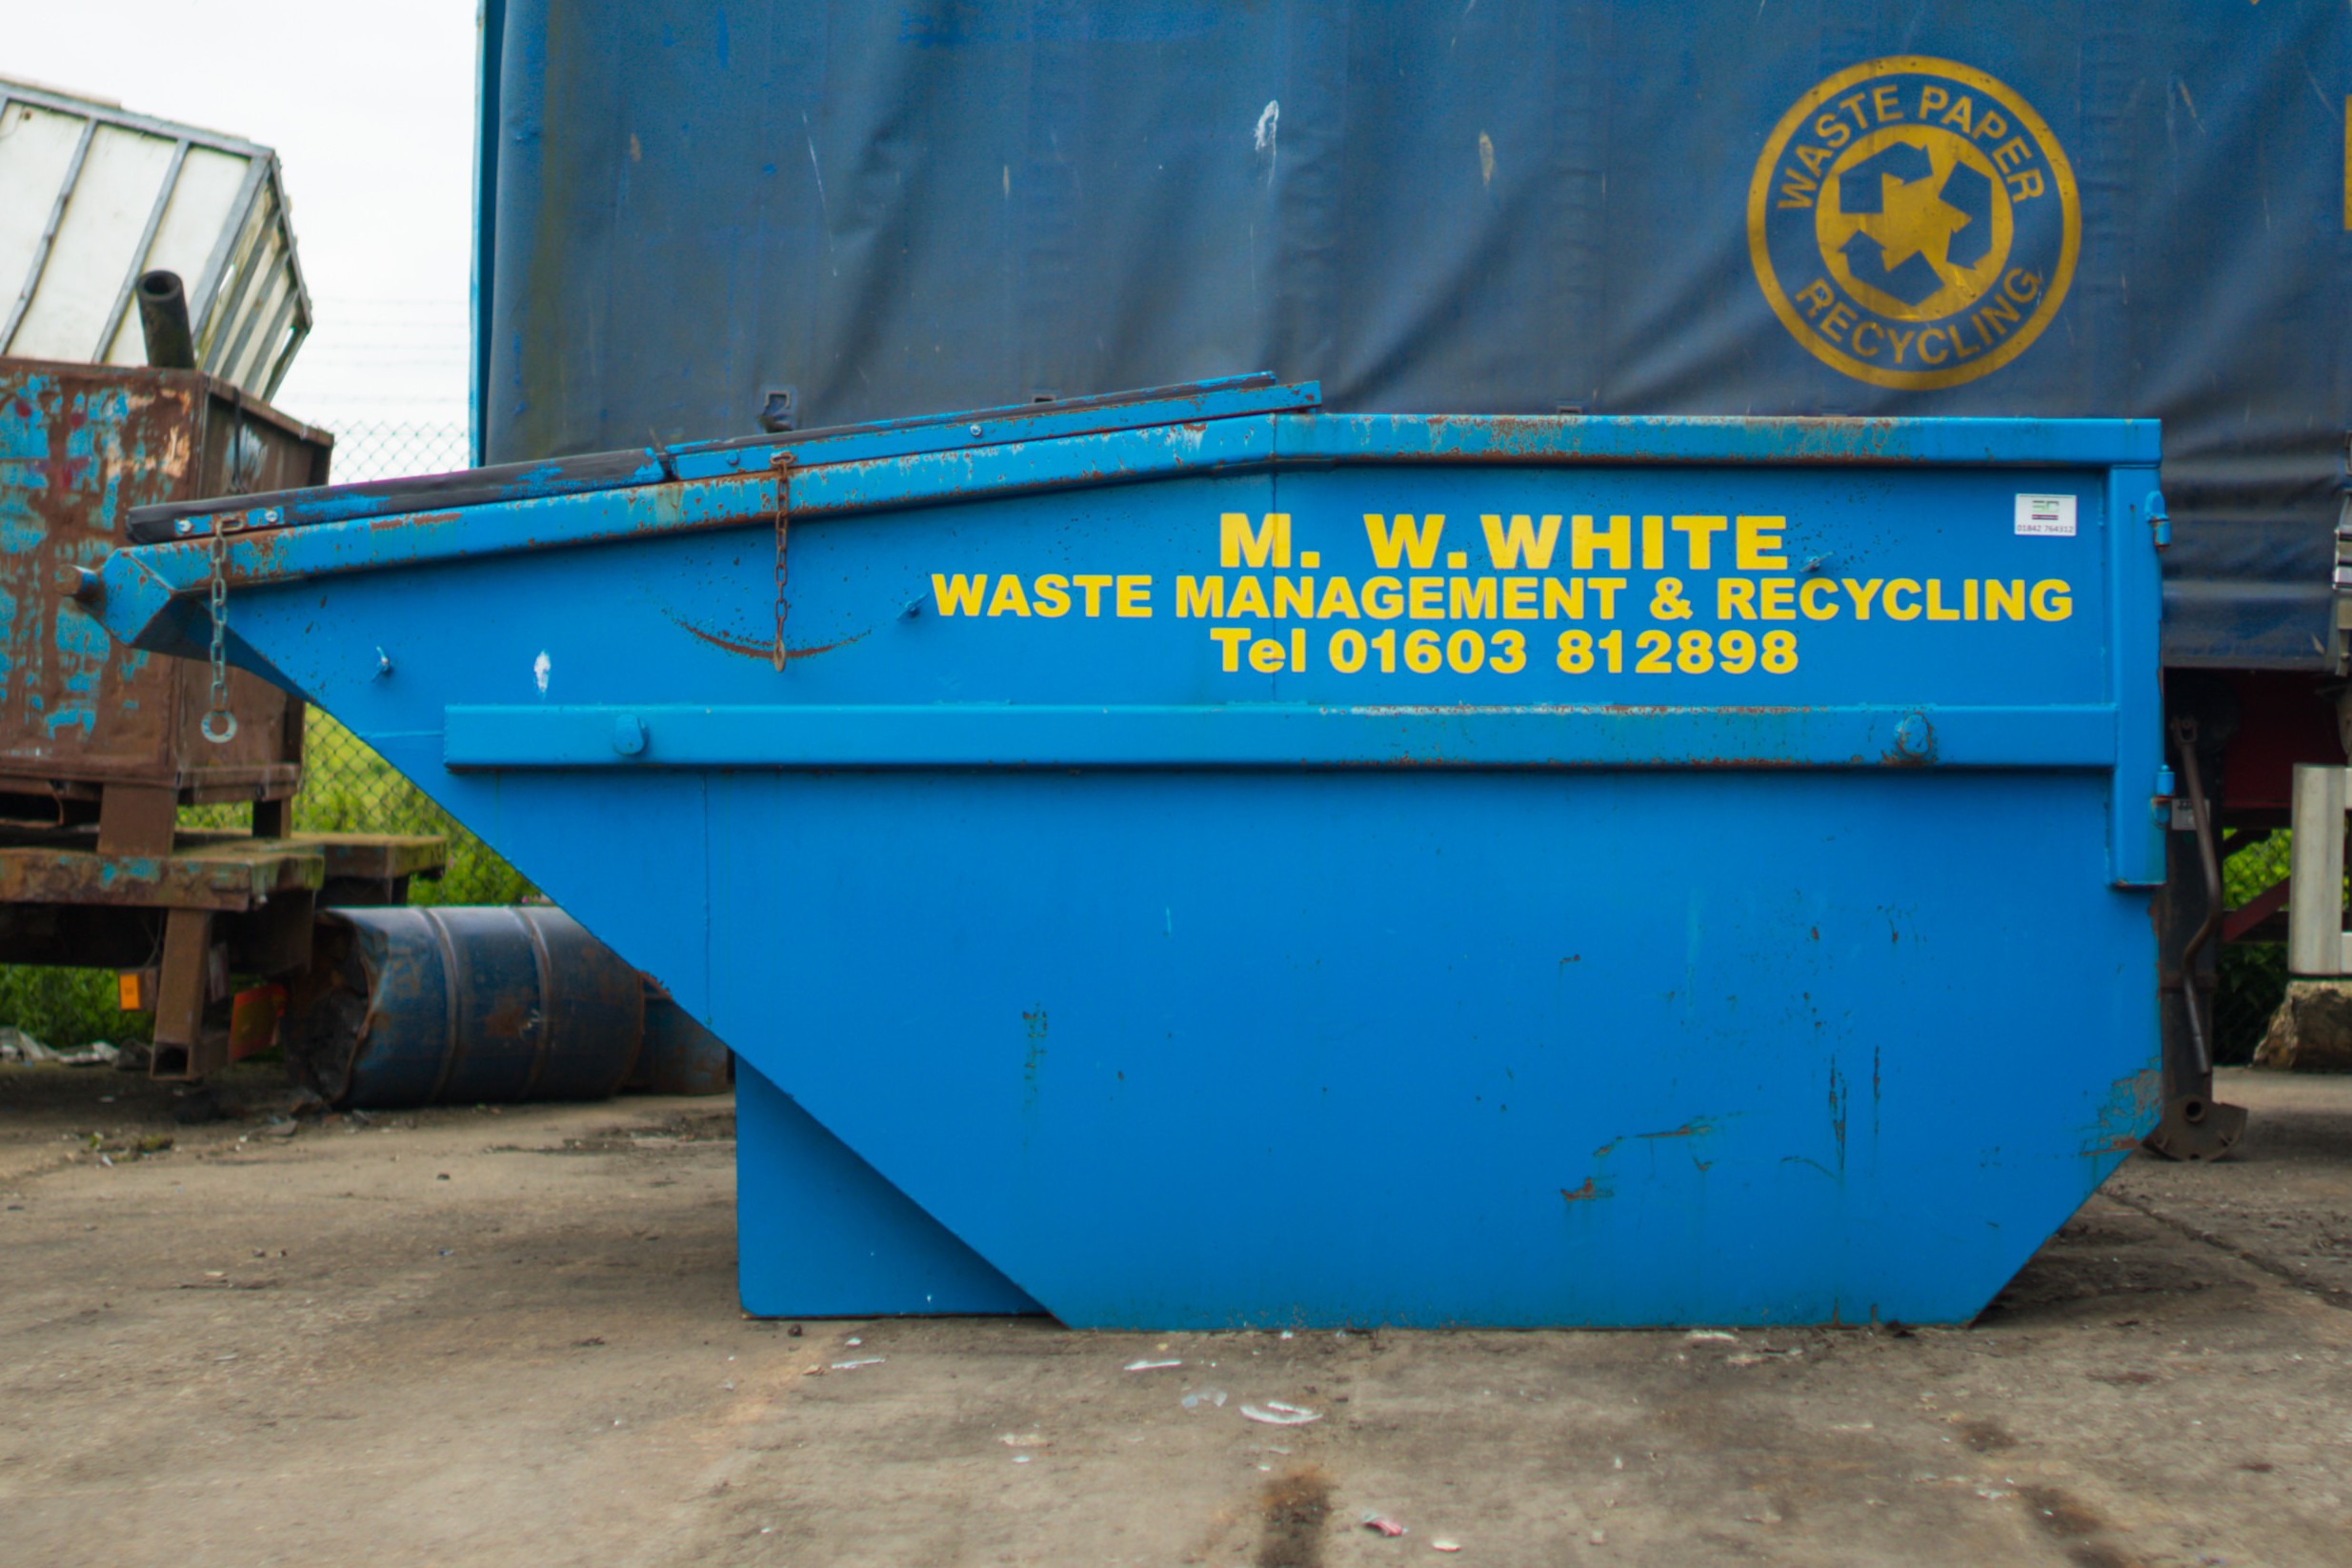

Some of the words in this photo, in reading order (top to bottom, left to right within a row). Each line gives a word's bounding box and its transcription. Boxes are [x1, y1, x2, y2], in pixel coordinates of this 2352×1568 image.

[1777, 84, 1904, 209] WASTE
[1918, 84, 2045, 203] PAPER
[1795, 268, 2040, 365] RECYCLING
[1220, 513, 1320, 569] M.
[1479, 514, 1788, 571] WHITE
[932, 573, 1153, 617] WASTE
[1176, 574, 1627, 620] MANAGEMENT
[1649, 576, 1693, 620] &
[1717, 577, 2073, 622] RECYCLING
[1210, 627, 1306, 673] Tel
[1329, 629, 1527, 674] 01603
[1556, 629, 1799, 674] 812898
